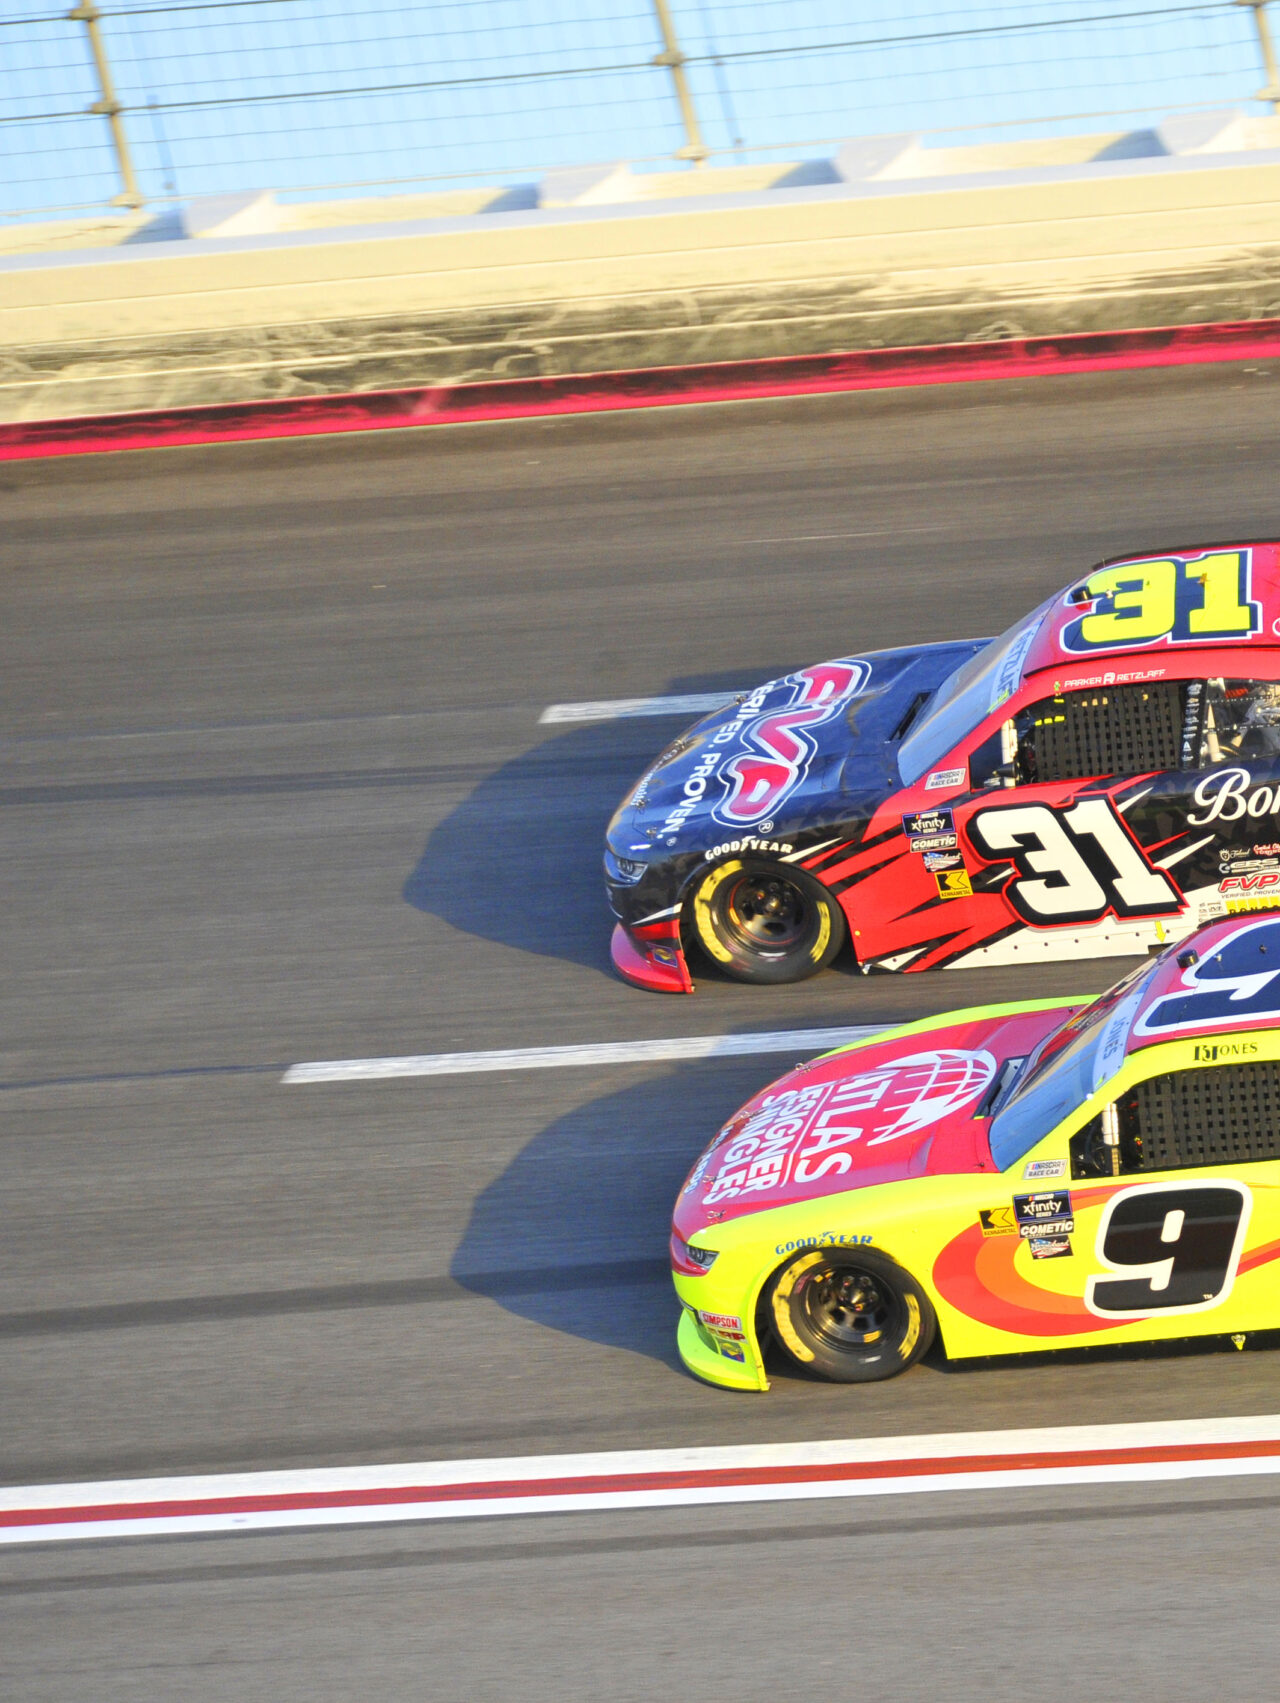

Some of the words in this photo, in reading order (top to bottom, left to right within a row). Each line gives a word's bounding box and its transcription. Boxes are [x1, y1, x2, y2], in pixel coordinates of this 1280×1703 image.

[1075, 550, 1257, 648] 31
[1064, 676, 1102, 688] PARKER
[1116, 669, 1166, 682] RETZLAFF
[717, 661, 864, 823] FVP
[656, 752, 722, 839] PROVEN.
[911, 818, 946, 832] xfinity
[705, 836, 793, 860] GOODYEAR
[911, 836, 956, 849] COMETIC
[974, 798, 1179, 917] 31
[1219, 872, 1280, 893] FVP
[1103, 1017, 1127, 1061] JONES
[793, 1068, 902, 1184] ATLAS
[702, 1090, 798, 1205] SHINGLES
[1023, 1200, 1062, 1216] xfinity
[1020, 1220, 1074, 1236] COMETIC
[775, 1232, 873, 1255] GOODYEAR
[1090, 1185, 1247, 1314] 9
[703, 1313, 738, 1329] SIMPSON
